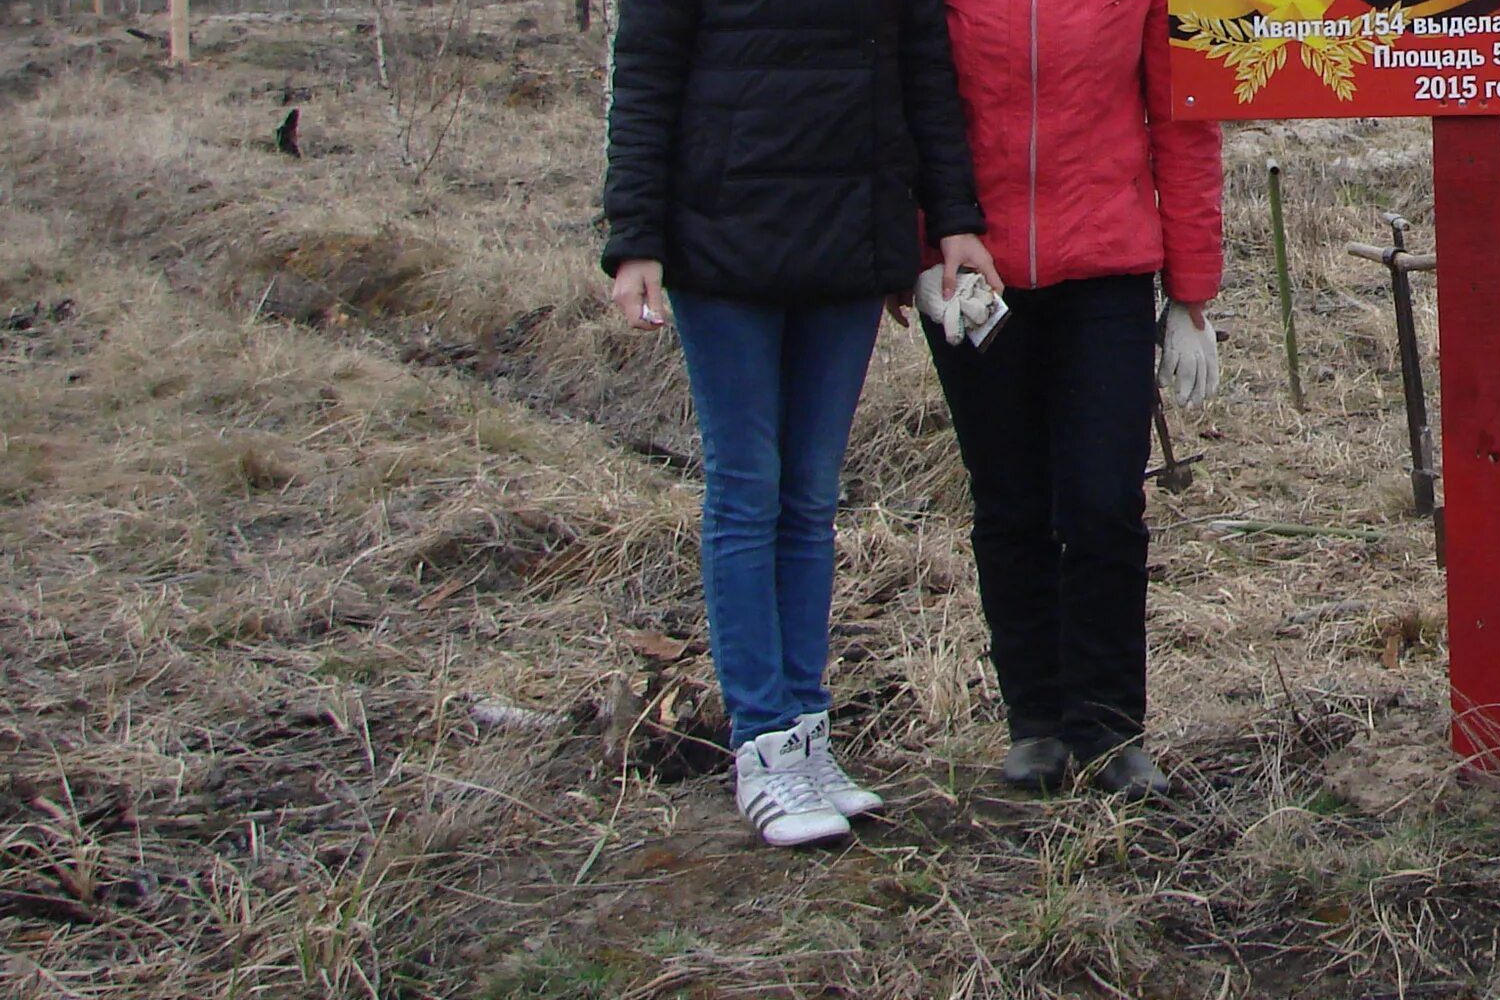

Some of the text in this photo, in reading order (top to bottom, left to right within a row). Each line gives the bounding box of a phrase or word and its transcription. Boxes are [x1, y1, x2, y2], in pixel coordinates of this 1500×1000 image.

[1253, 16, 1351, 41] Квартал
[1361, 12, 1406, 36] 154
[1374, 45, 1485, 69] Площадь
[1415, 76, 1478, 99] 2015
